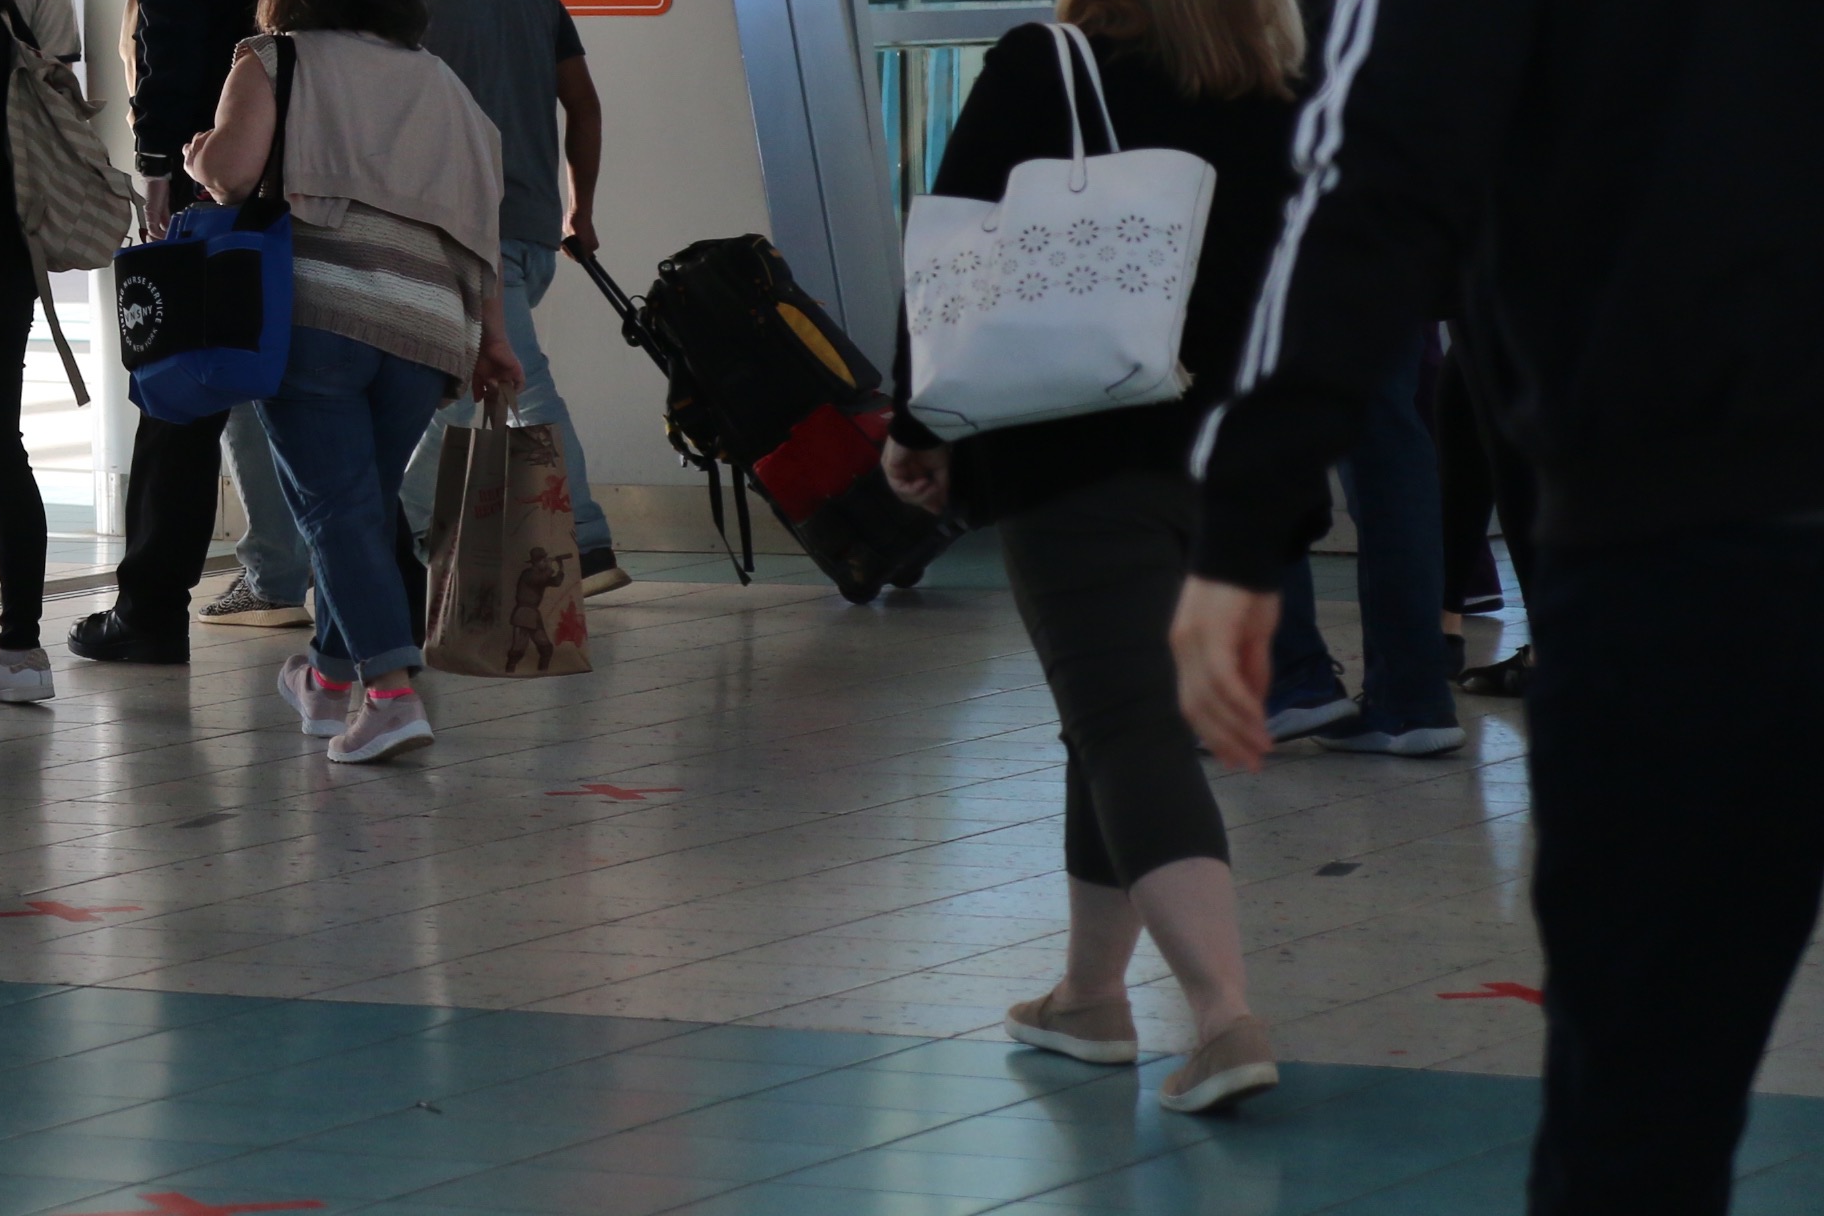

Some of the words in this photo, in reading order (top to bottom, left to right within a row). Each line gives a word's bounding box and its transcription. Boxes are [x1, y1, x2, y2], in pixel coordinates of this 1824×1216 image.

[123, 276, 146, 289] NURSE
[147, 282, 163, 324] SERVICE
[133, 344, 145, 352] NEW
[145, 328, 158, 348] YORK
